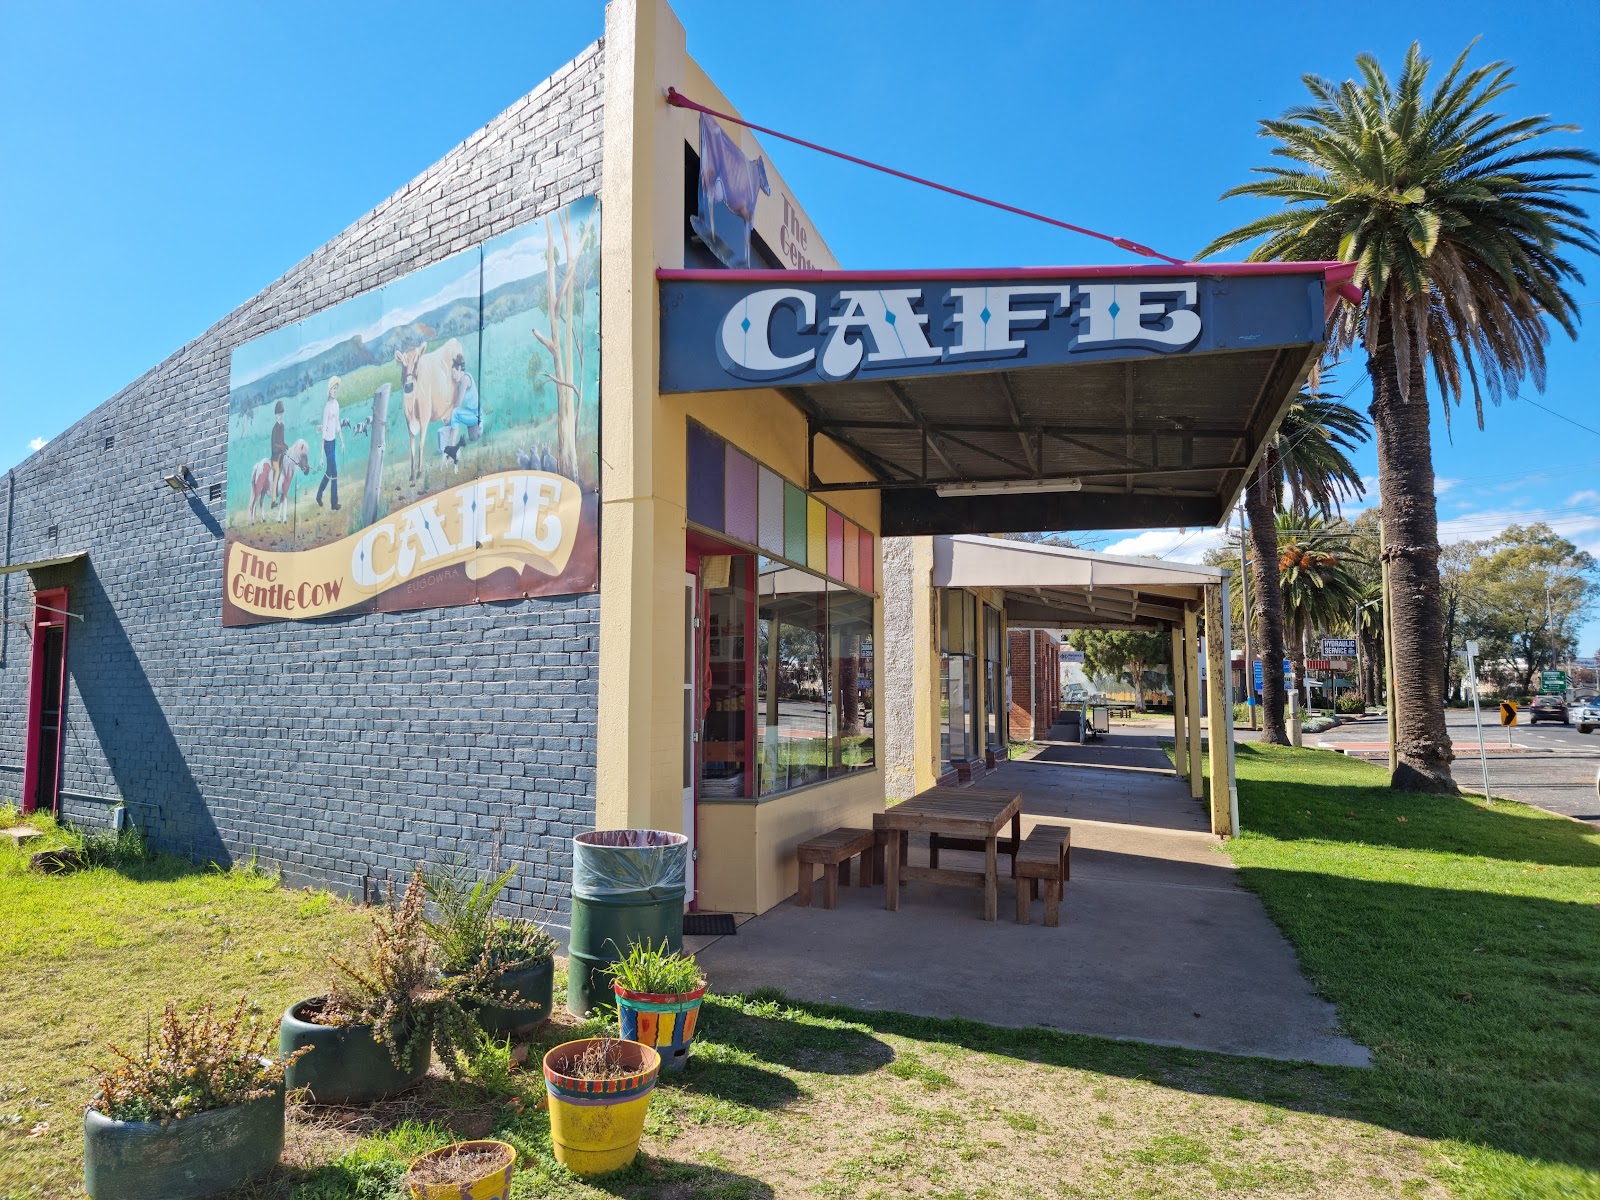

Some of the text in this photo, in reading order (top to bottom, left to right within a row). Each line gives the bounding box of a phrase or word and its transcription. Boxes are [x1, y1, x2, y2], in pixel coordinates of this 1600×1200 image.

[781, 192, 808, 251] The
[780, 224, 816, 270] Gen
[719, 281, 1202, 377] CAFE
[351, 475, 563, 586] CAFE
[241, 550, 278, 582] The
[407, 568, 460, 594] EUGOWRA
[232, 573, 296, 611] Gentle
[1324, 647, 1348, 655] SERVICE
